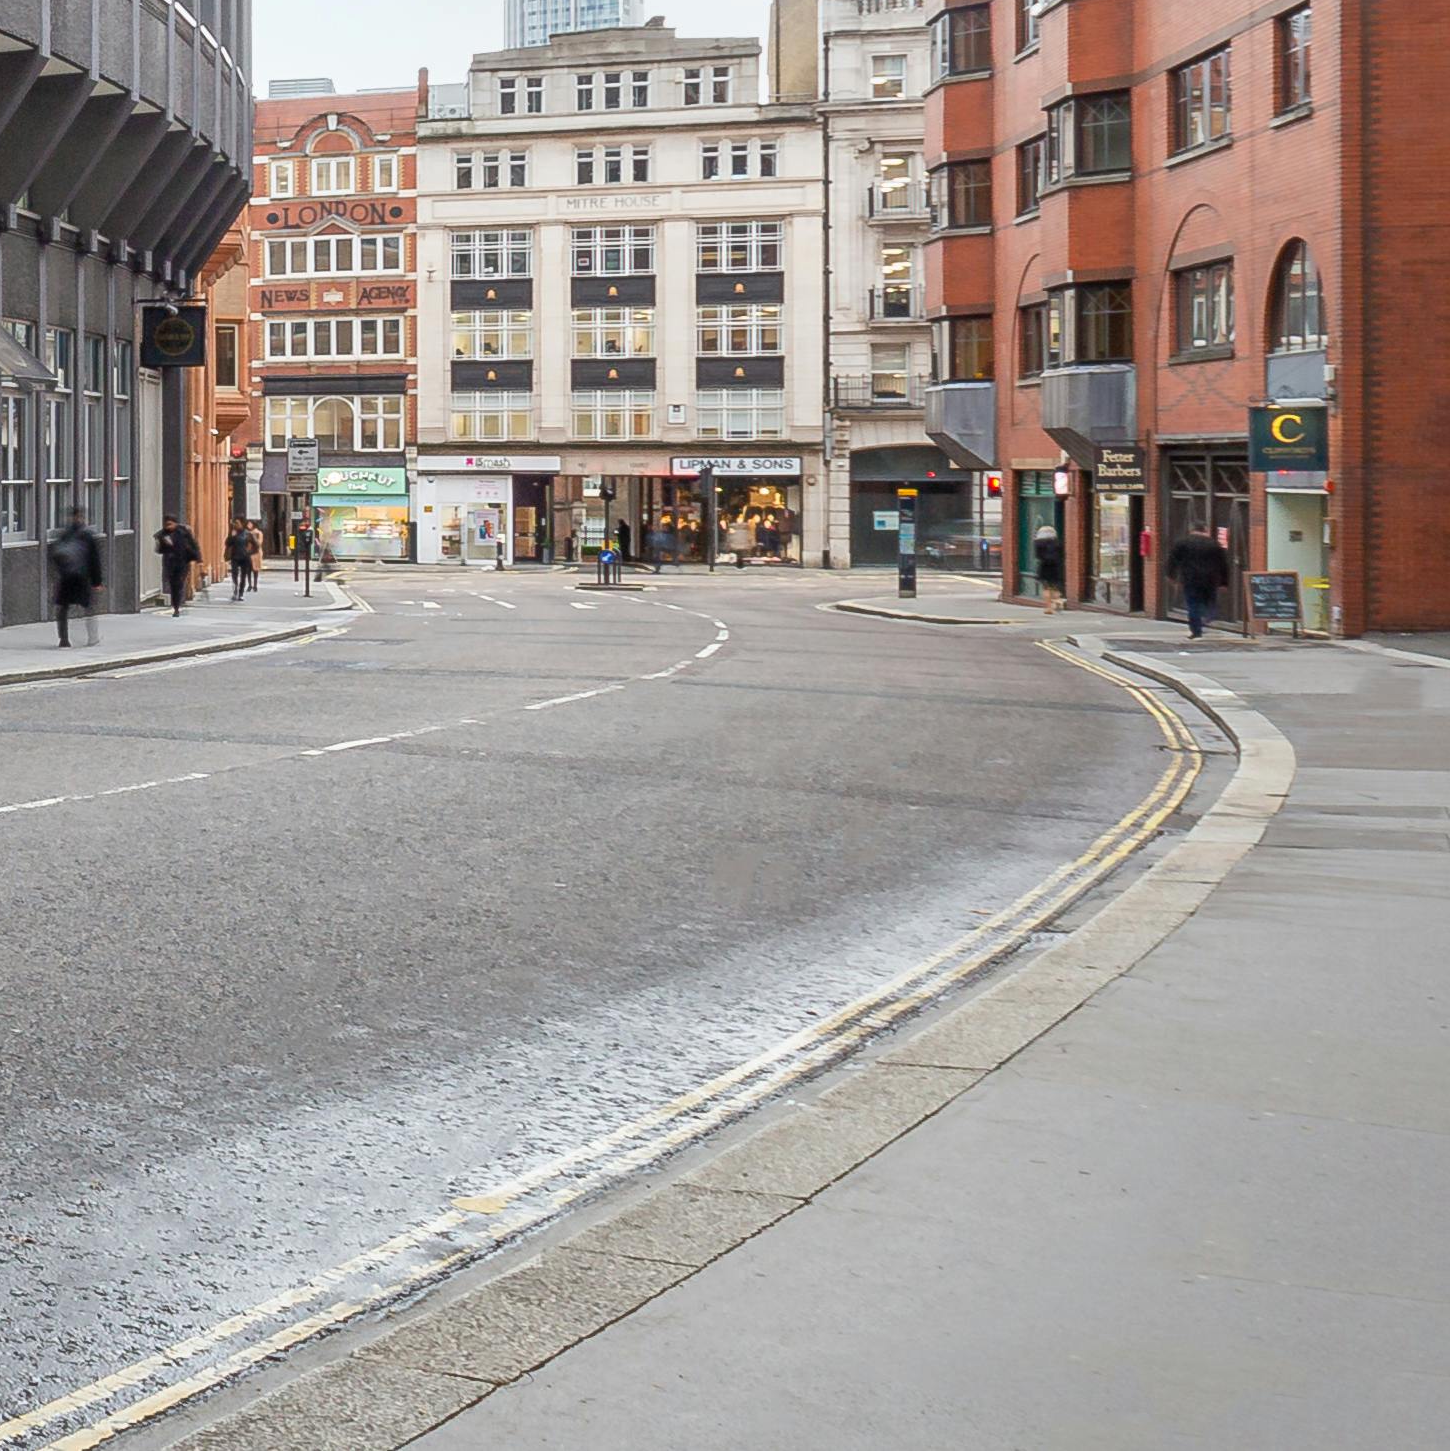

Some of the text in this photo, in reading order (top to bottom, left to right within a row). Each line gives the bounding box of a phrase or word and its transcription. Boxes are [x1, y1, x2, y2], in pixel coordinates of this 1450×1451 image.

[566, 195, 660, 209] MITRE HOUSE
[282, 200, 388, 229] LONDON
[260, 288, 310, 309] NEWS
[1271, 414, 1305, 443] C
[752, 459, 793, 469] SONS
